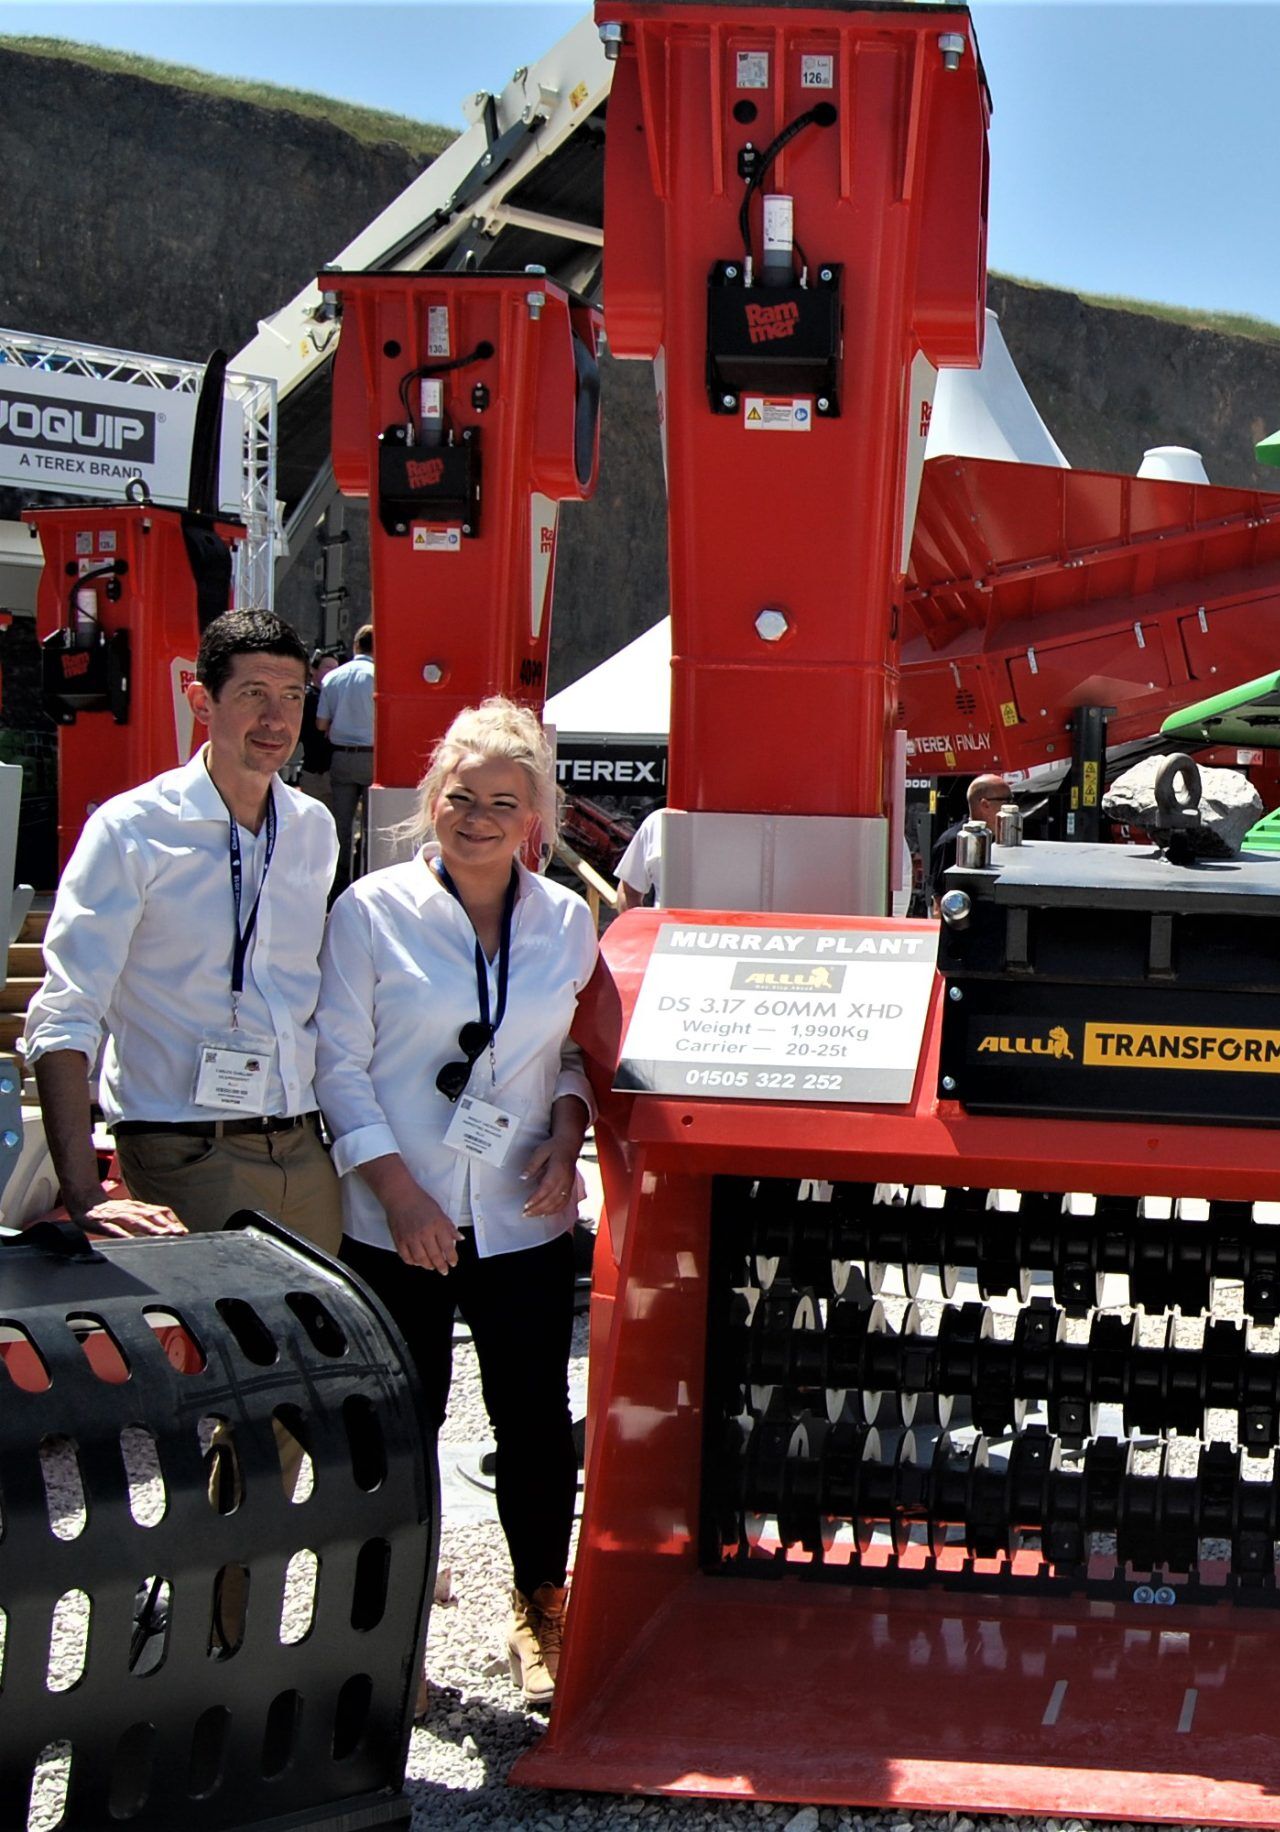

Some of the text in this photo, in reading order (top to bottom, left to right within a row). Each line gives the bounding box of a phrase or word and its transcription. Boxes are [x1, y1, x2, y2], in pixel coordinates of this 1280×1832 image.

[803, 72, 822, 84] 126
[745, 301, 799, 327] Ram
[749, 321, 796, 343] mer
[0, 400, 145, 450] OQUIP
[19, 453, 143, 479] A TEREX BRAND
[915, 733, 991, 753] TEREX FINLAY
[556, 760, 656, 782] TEREX
[670, 930, 923, 955] MURRAY PLANT
[745, 973, 816, 986] ALLU
[657, 996, 903, 1019] DS 3.17 60MM XHD
[682, 1020, 752, 1037] Weight
[790, 1024, 869, 1042] 1,990Kg
[676, 1038, 748, 1054] Carrier
[785, 1043, 848, 1058] 20-25t
[977, 1035, 1055, 1055] ALLU
[685, 1069, 843, 1090] 01505 322 252
